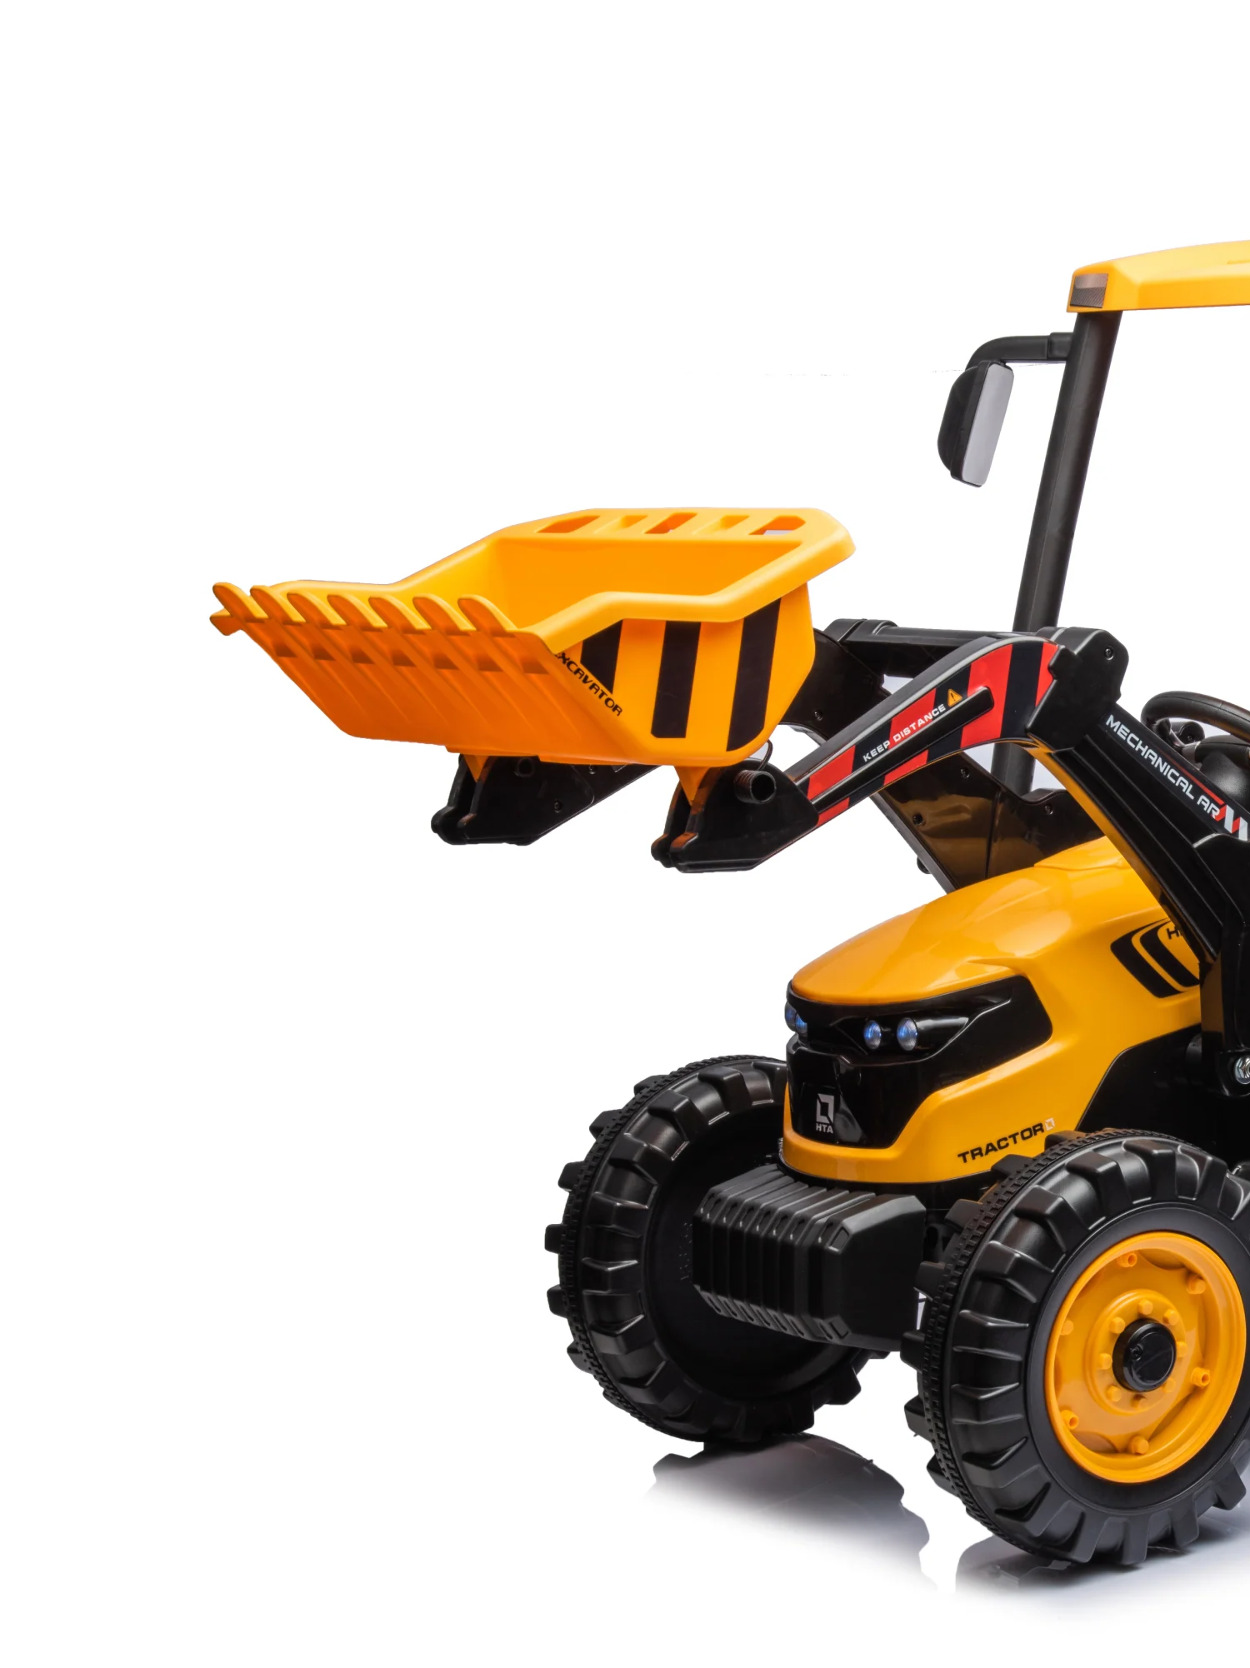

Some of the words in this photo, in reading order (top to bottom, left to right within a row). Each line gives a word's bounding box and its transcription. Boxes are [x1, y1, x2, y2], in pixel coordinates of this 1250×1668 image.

[862, 740, 891, 762] KEEP
[893, 703, 946, 742] DISTANCE
[1105, 714, 1195, 800] MECHANICAL
[815, 1122, 834, 1134] HTA
[957, 1122, 1045, 1164] TRACTOR
